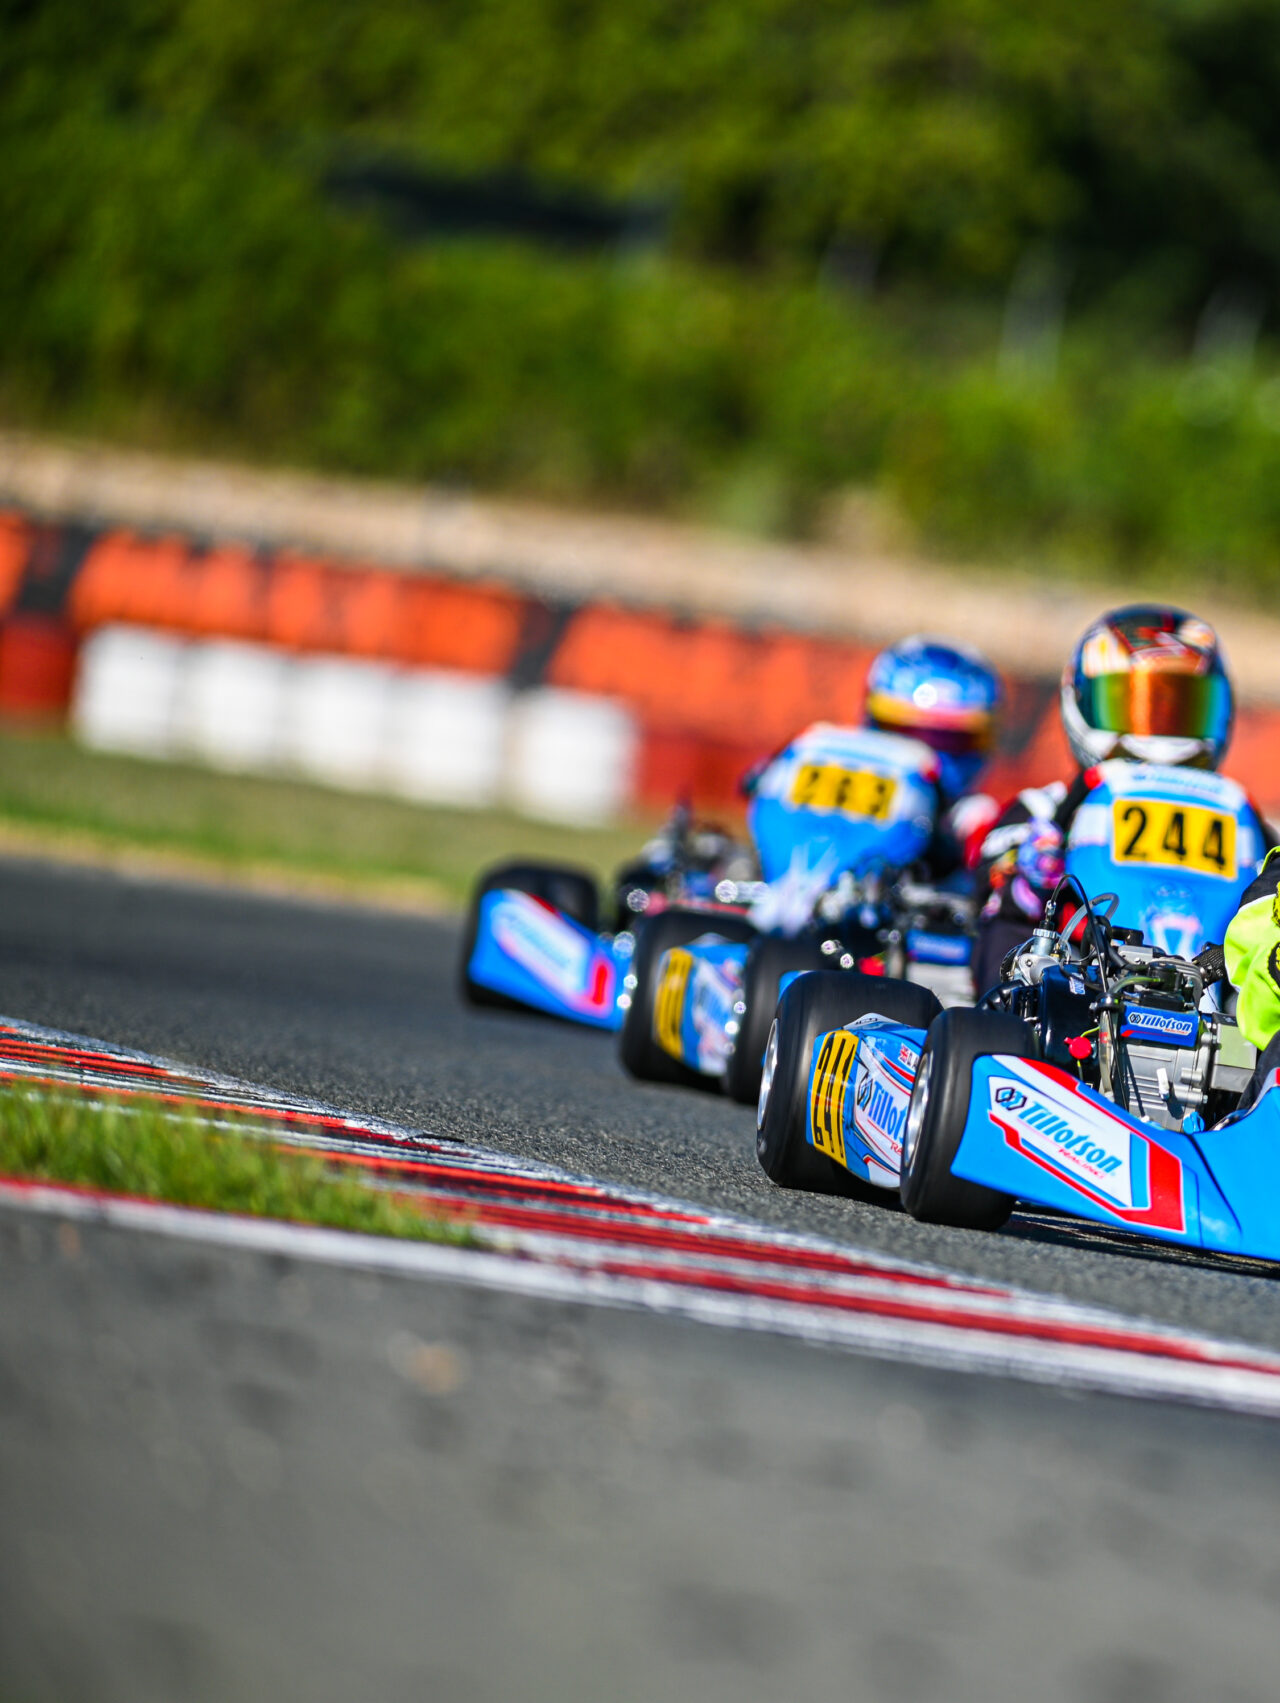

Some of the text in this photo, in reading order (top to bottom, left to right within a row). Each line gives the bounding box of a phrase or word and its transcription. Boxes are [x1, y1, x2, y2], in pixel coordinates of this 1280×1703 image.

[1122, 805, 1226, 870] 244
[1140, 1013, 1193, 1032] Tillotson
[868, 1080, 909, 1143] Tillot
[1017, 1100, 1123, 1174] Tillotson
